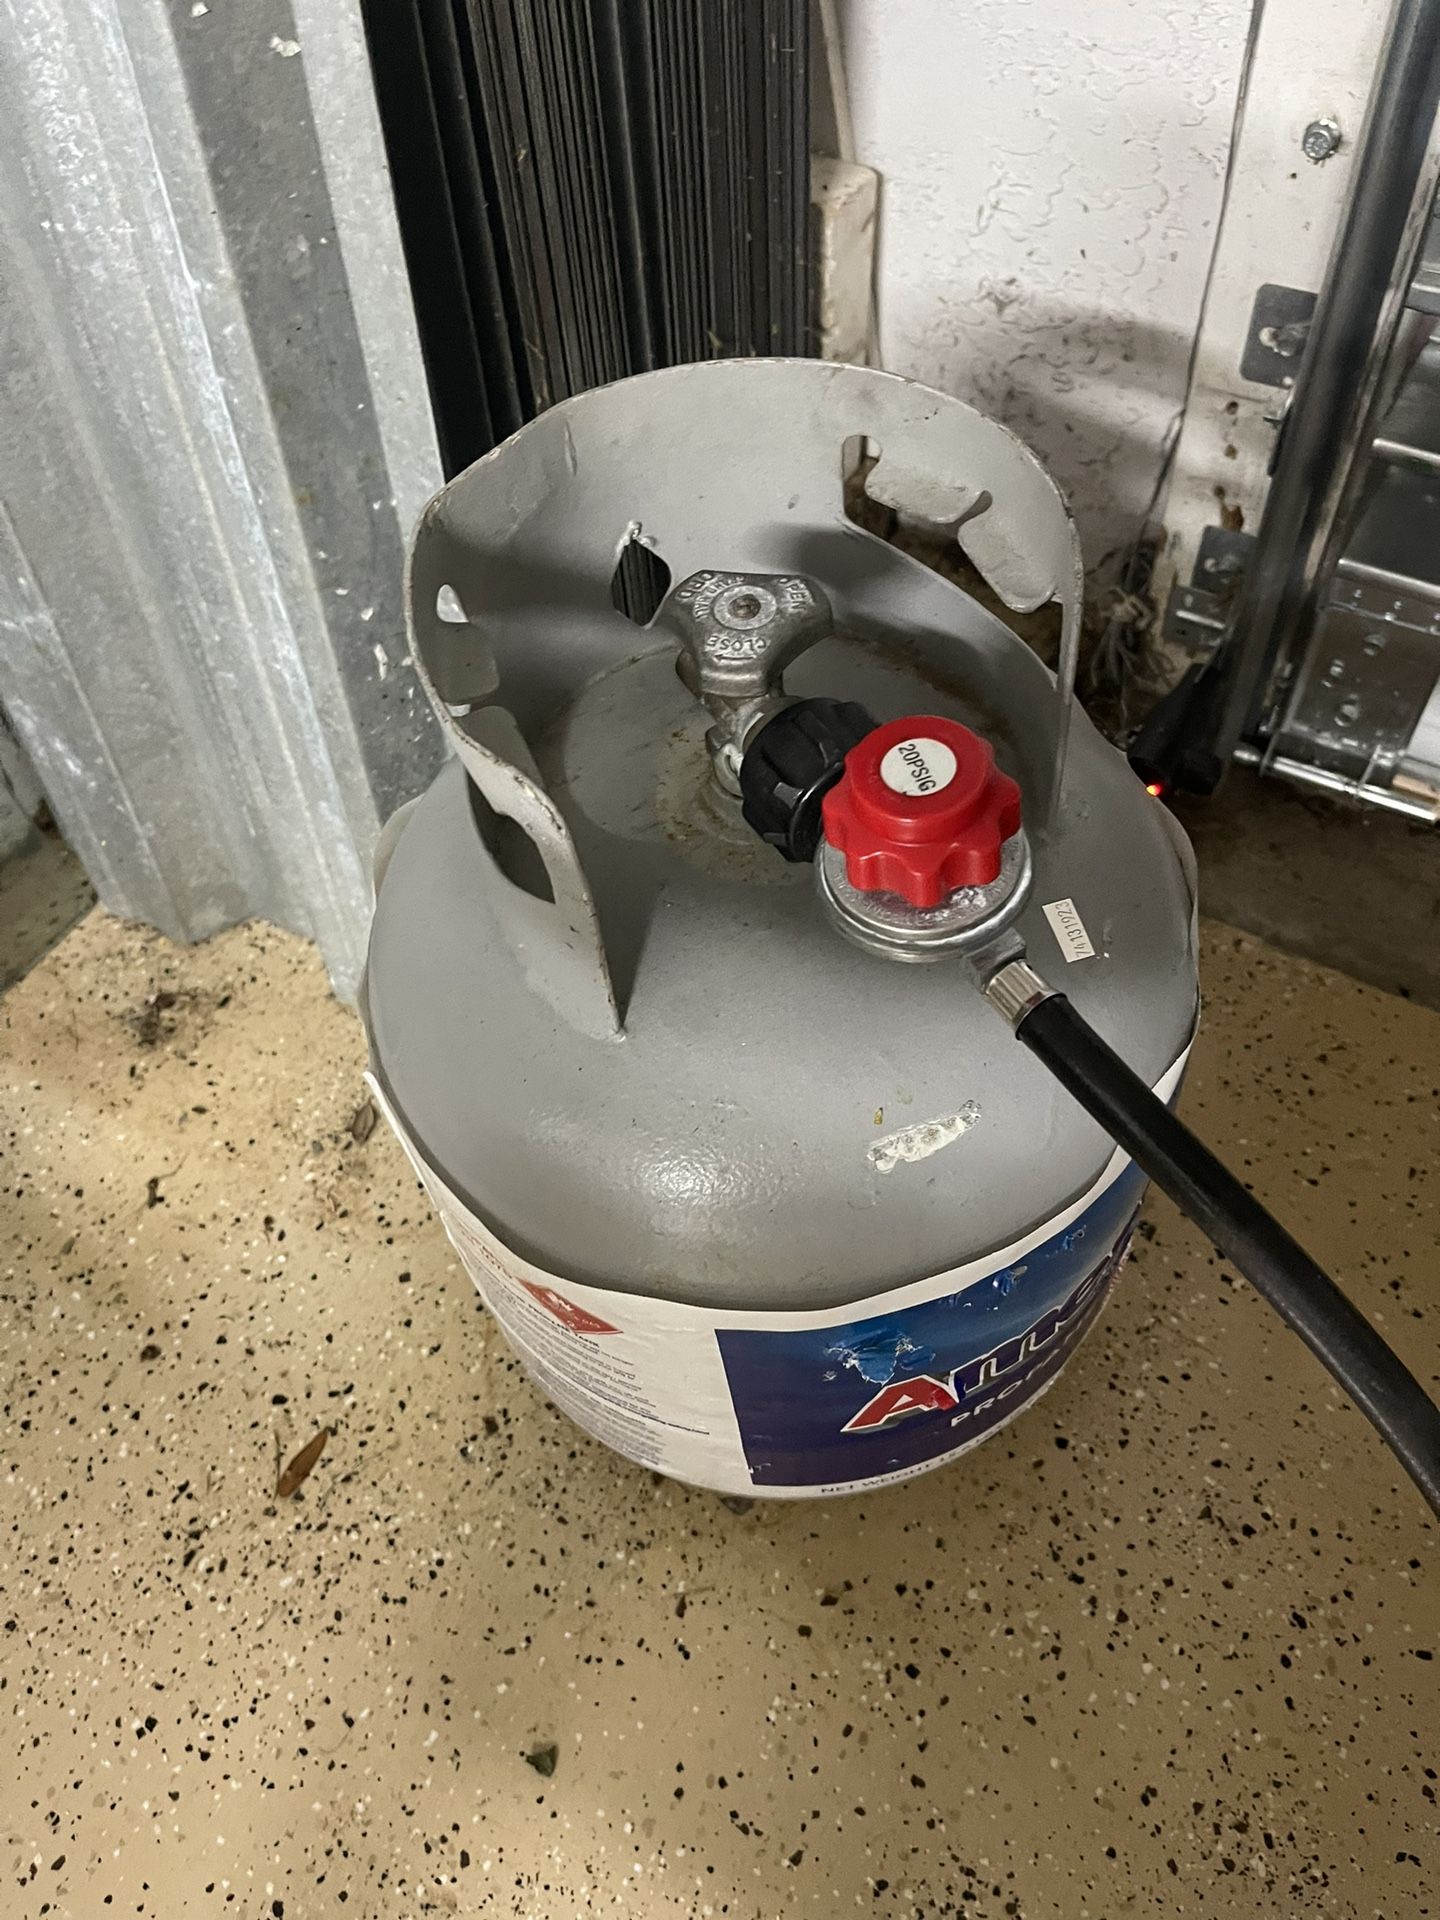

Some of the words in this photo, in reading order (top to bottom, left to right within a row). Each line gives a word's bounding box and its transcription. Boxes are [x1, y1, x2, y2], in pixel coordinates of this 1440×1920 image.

[777, 576, 809, 611] OPEN
[705, 634, 768, 652] CLOSE
[898, 743, 937, 792] 20PSIG
